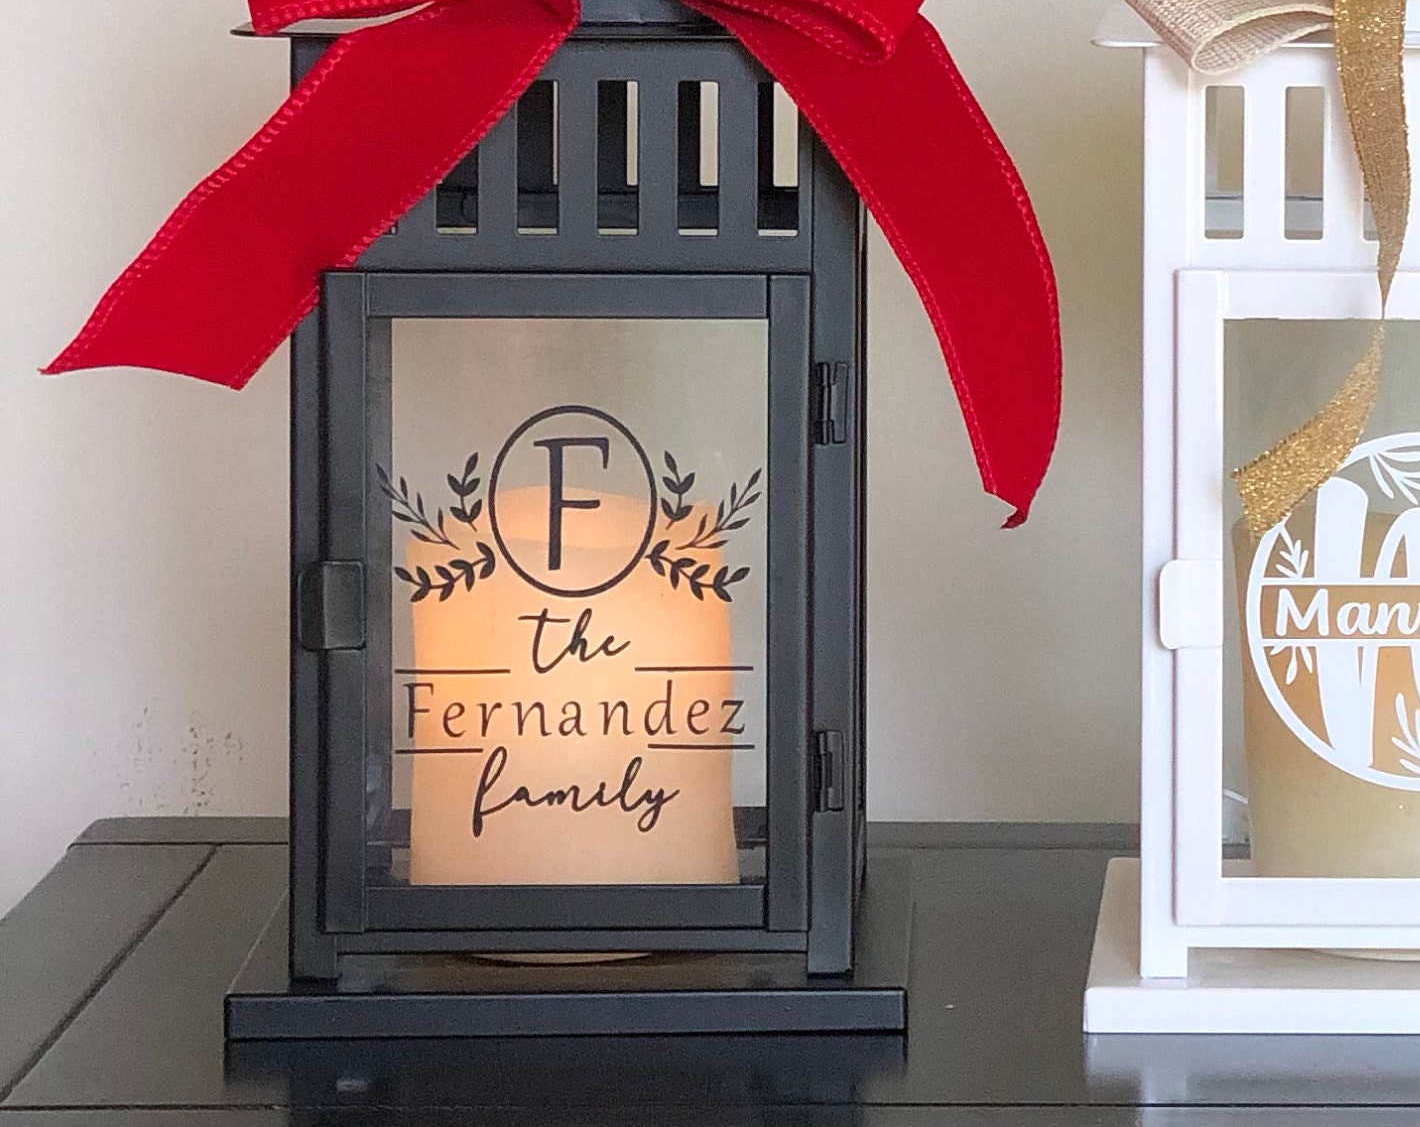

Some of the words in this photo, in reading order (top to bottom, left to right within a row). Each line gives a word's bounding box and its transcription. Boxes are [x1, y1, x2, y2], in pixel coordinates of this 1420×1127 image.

[532, 436, 610, 571] F
[517, 607, 632, 675] the
[402, 679, 747, 739] Fernandez
[471, 746, 681, 838] family
